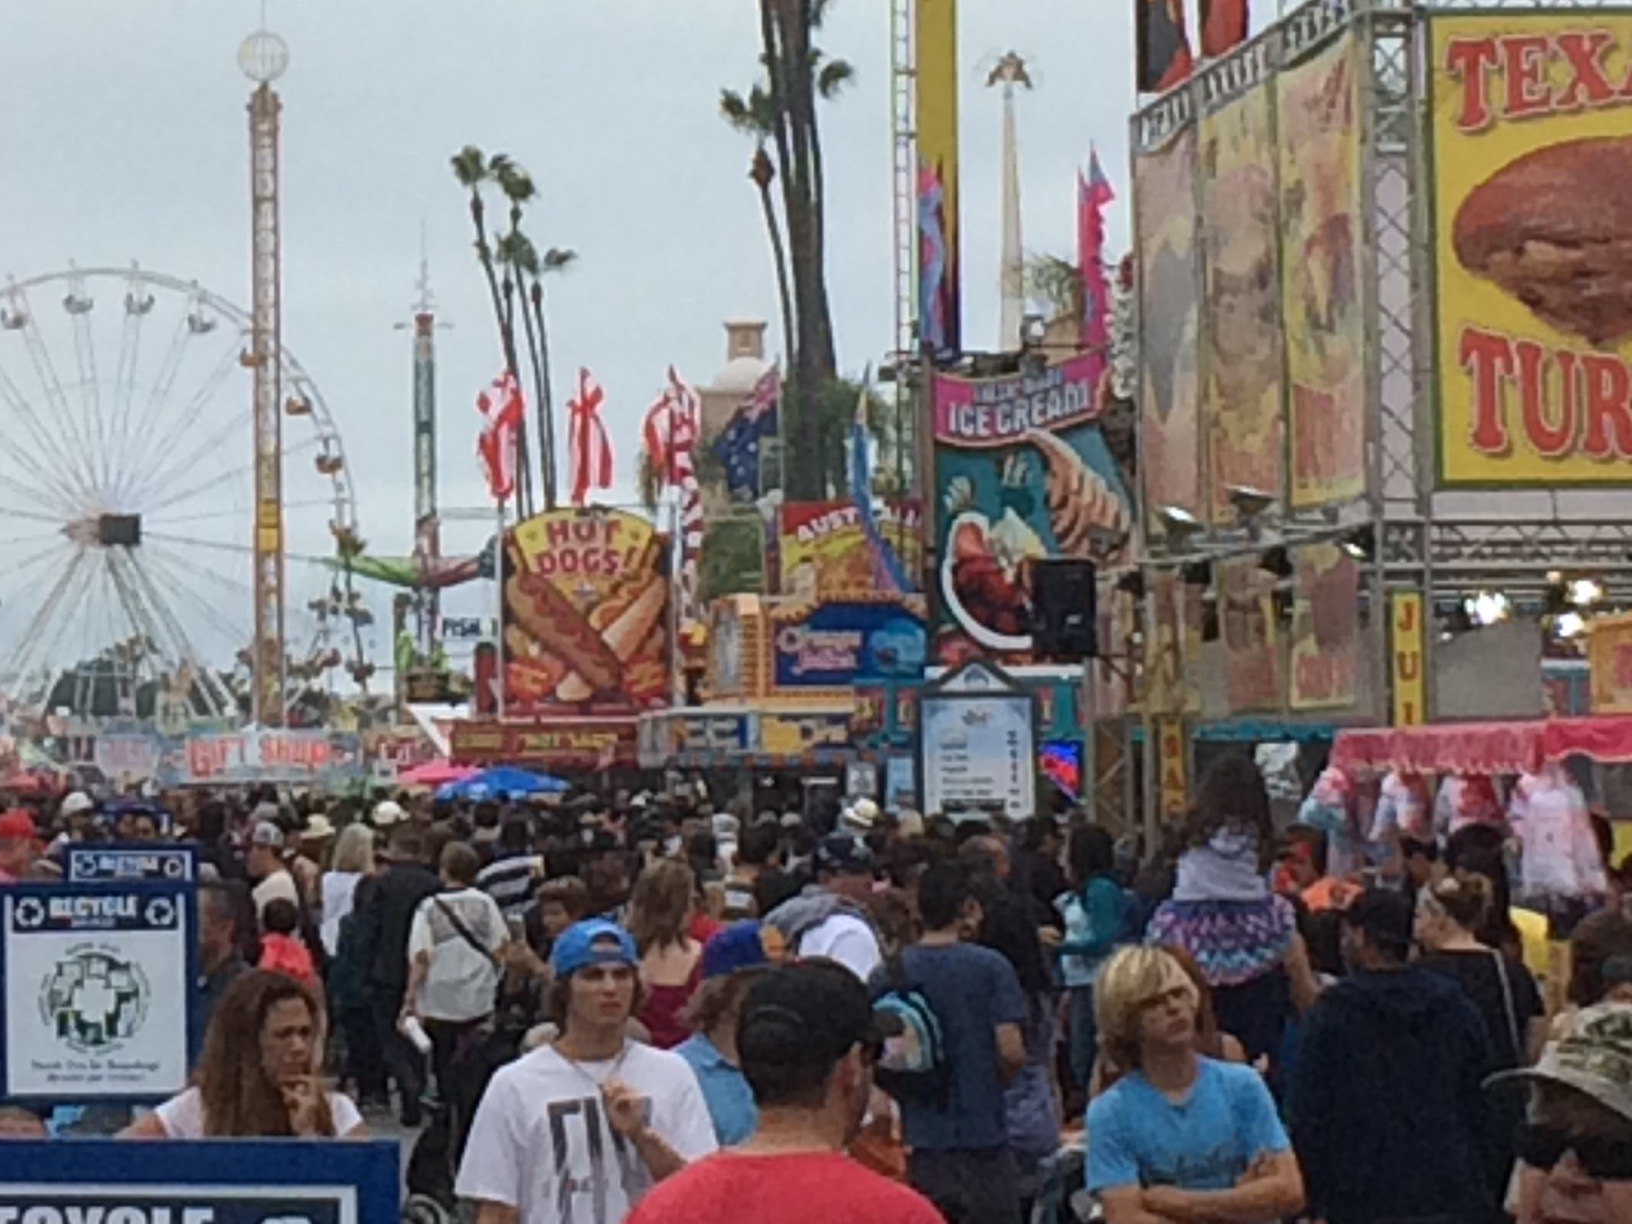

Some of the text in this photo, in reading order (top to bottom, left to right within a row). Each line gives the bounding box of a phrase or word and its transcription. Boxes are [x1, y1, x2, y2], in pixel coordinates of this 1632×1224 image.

[1444, 29, 1632, 132] TEX
[948, 401, 991, 436] ICE
[996, 377, 1091, 435] CREAM
[546, 519, 621, 545] HOT
[536, 548, 638, 576] DOGS!
[48, 895, 138, 917] RECYCLE
